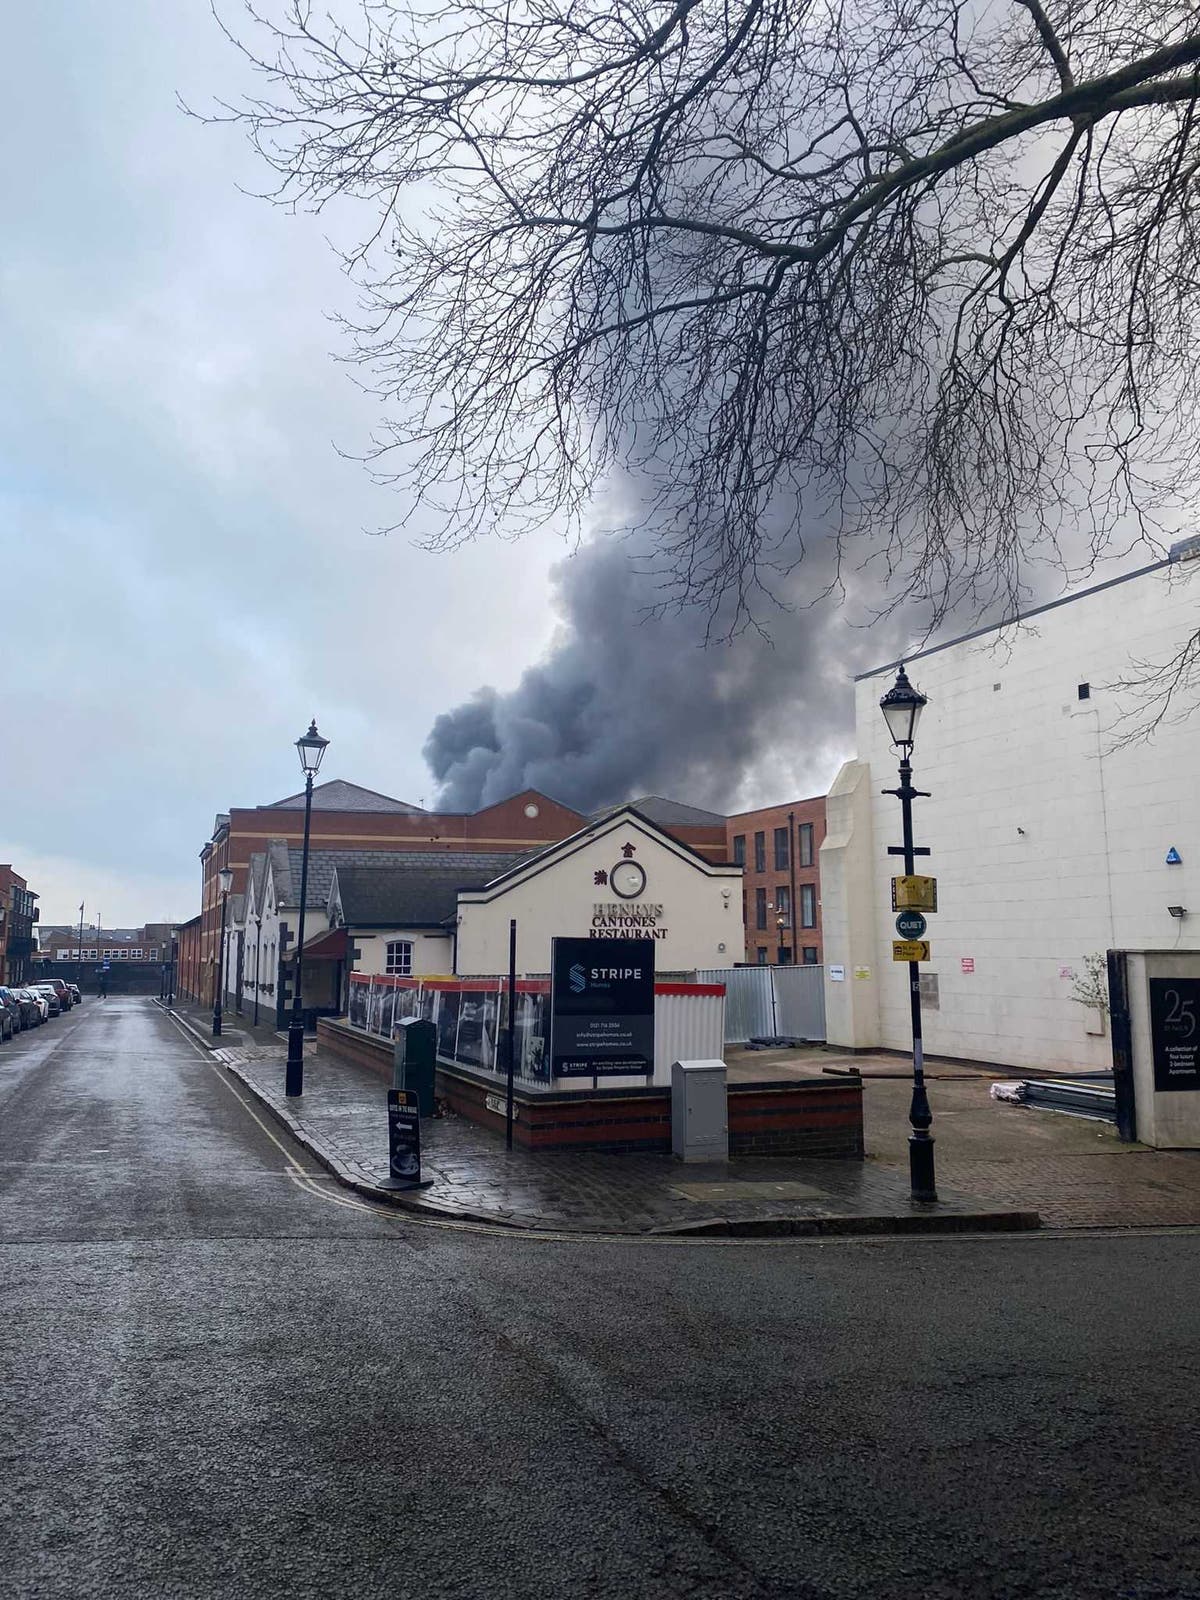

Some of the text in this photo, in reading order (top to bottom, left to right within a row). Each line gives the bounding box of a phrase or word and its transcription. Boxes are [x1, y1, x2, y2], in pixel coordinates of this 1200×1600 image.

[591, 916, 656, 928] CANTONES
[589, 928, 668, 939] RESTAURANT
[591, 968, 642, 979] STRIPE
[1164, 989, 1196, 1038] 25
